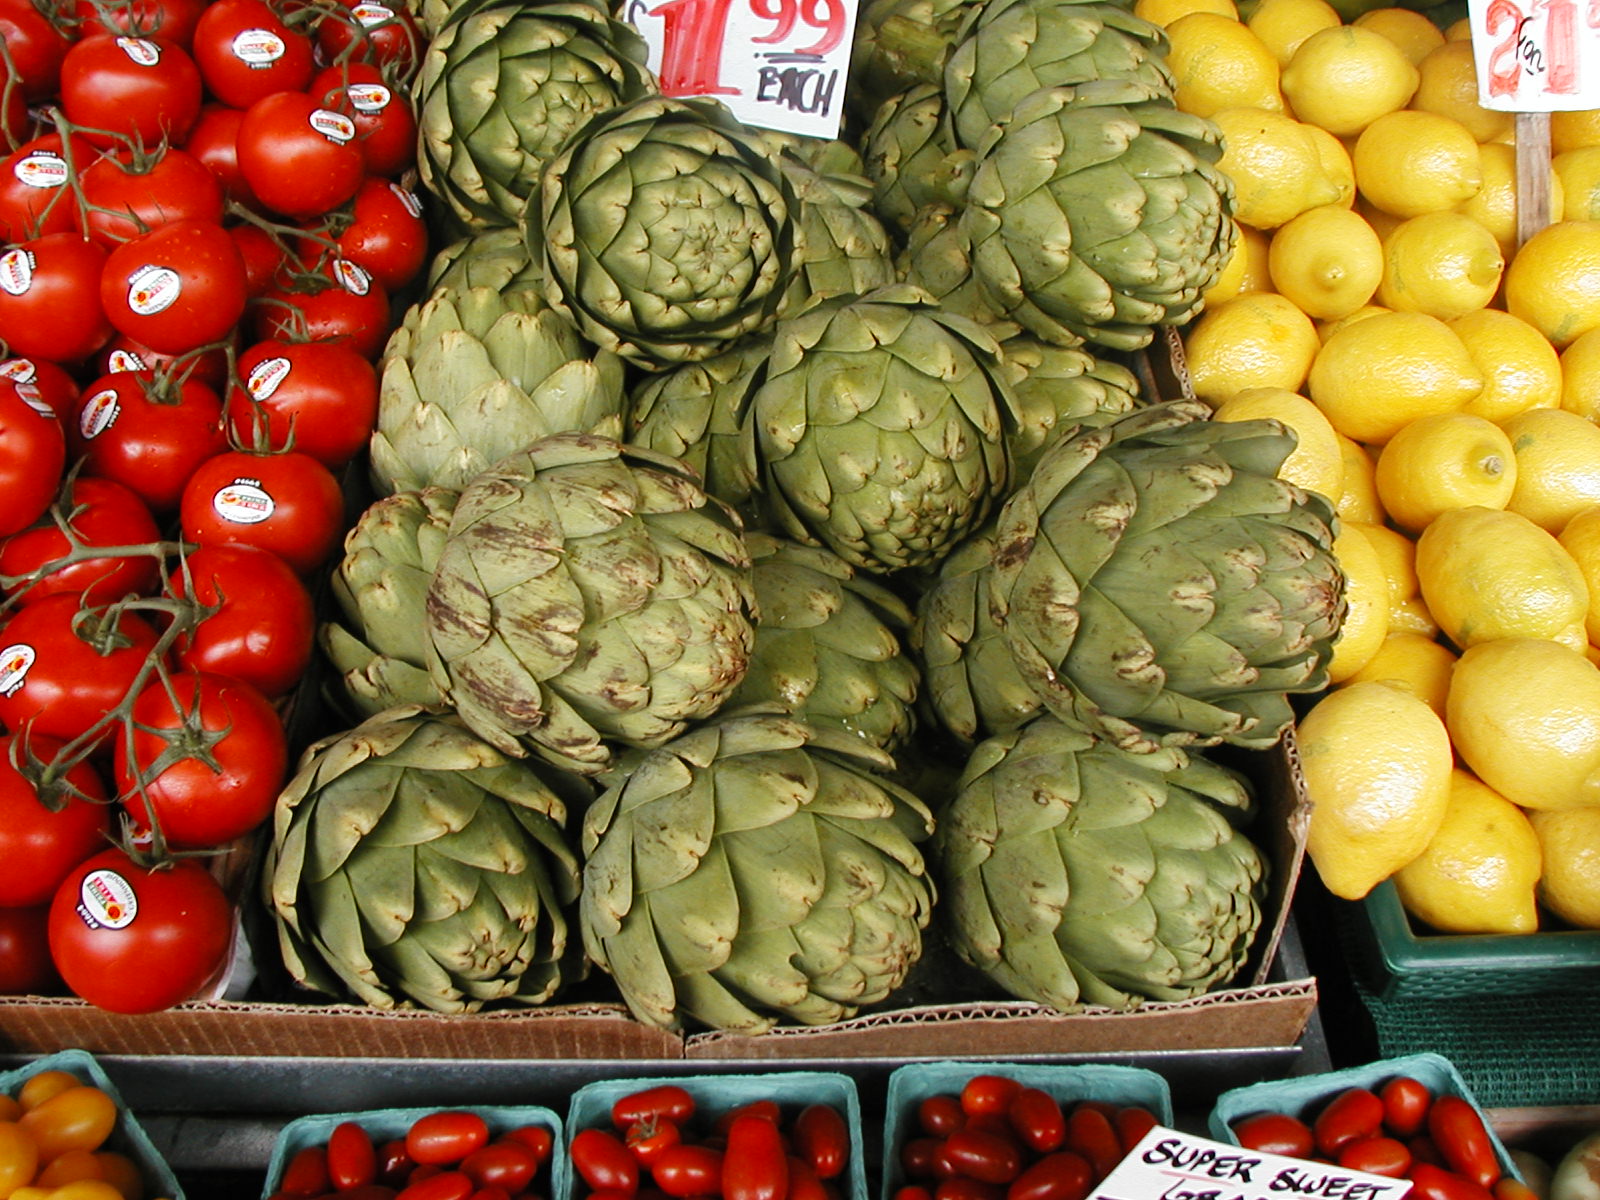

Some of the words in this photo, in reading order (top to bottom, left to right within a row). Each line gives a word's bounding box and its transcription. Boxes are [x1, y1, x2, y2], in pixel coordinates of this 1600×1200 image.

[751, 0, 846, 54] 99
[1486, 0, 1522, 99] 2
[757, 66, 838, 117] EACH
[1142, 1138, 1261, 1184] SUPER
[1269, 1168, 1393, 1200] SWEET
